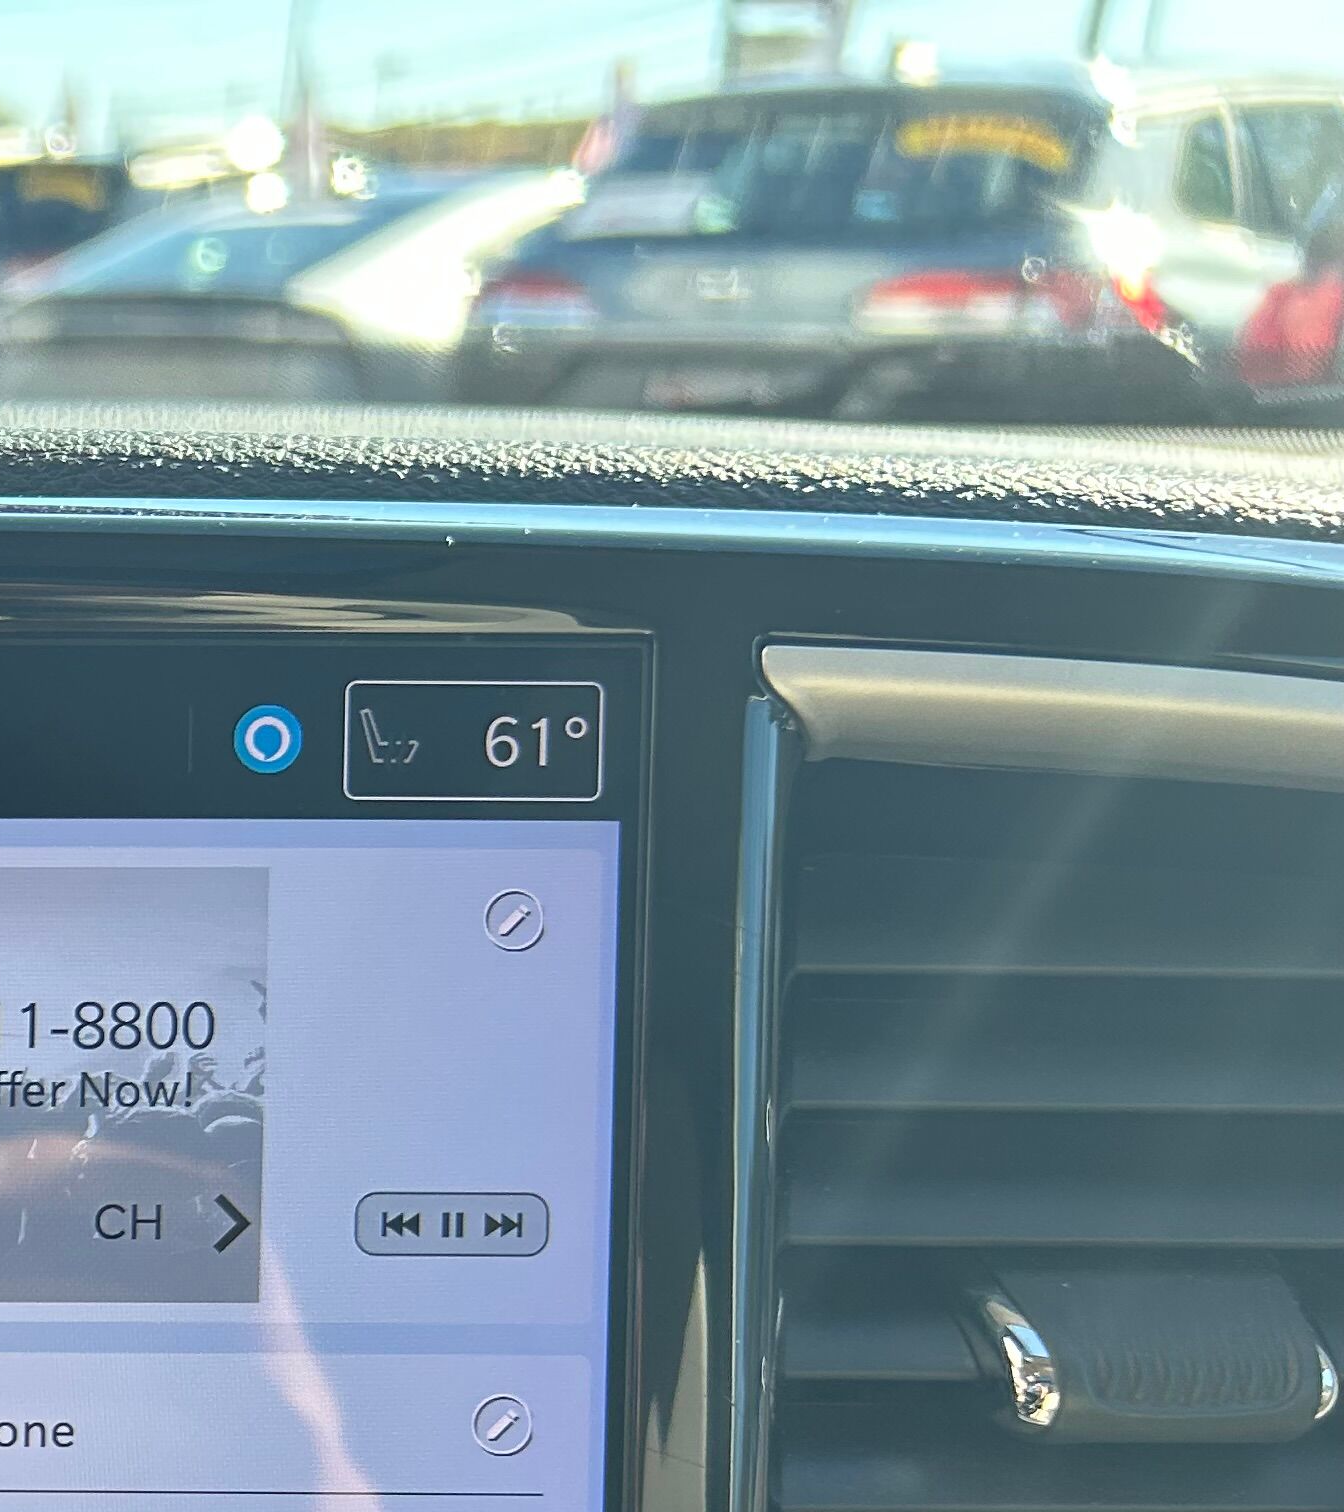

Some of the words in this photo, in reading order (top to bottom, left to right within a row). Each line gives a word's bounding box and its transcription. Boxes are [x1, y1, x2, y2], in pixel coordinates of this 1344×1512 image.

[485, 716, 588, 768] 61°
[79, 1071, 193, 1108] Now!
[95, 1204, 162, 1240] CH
